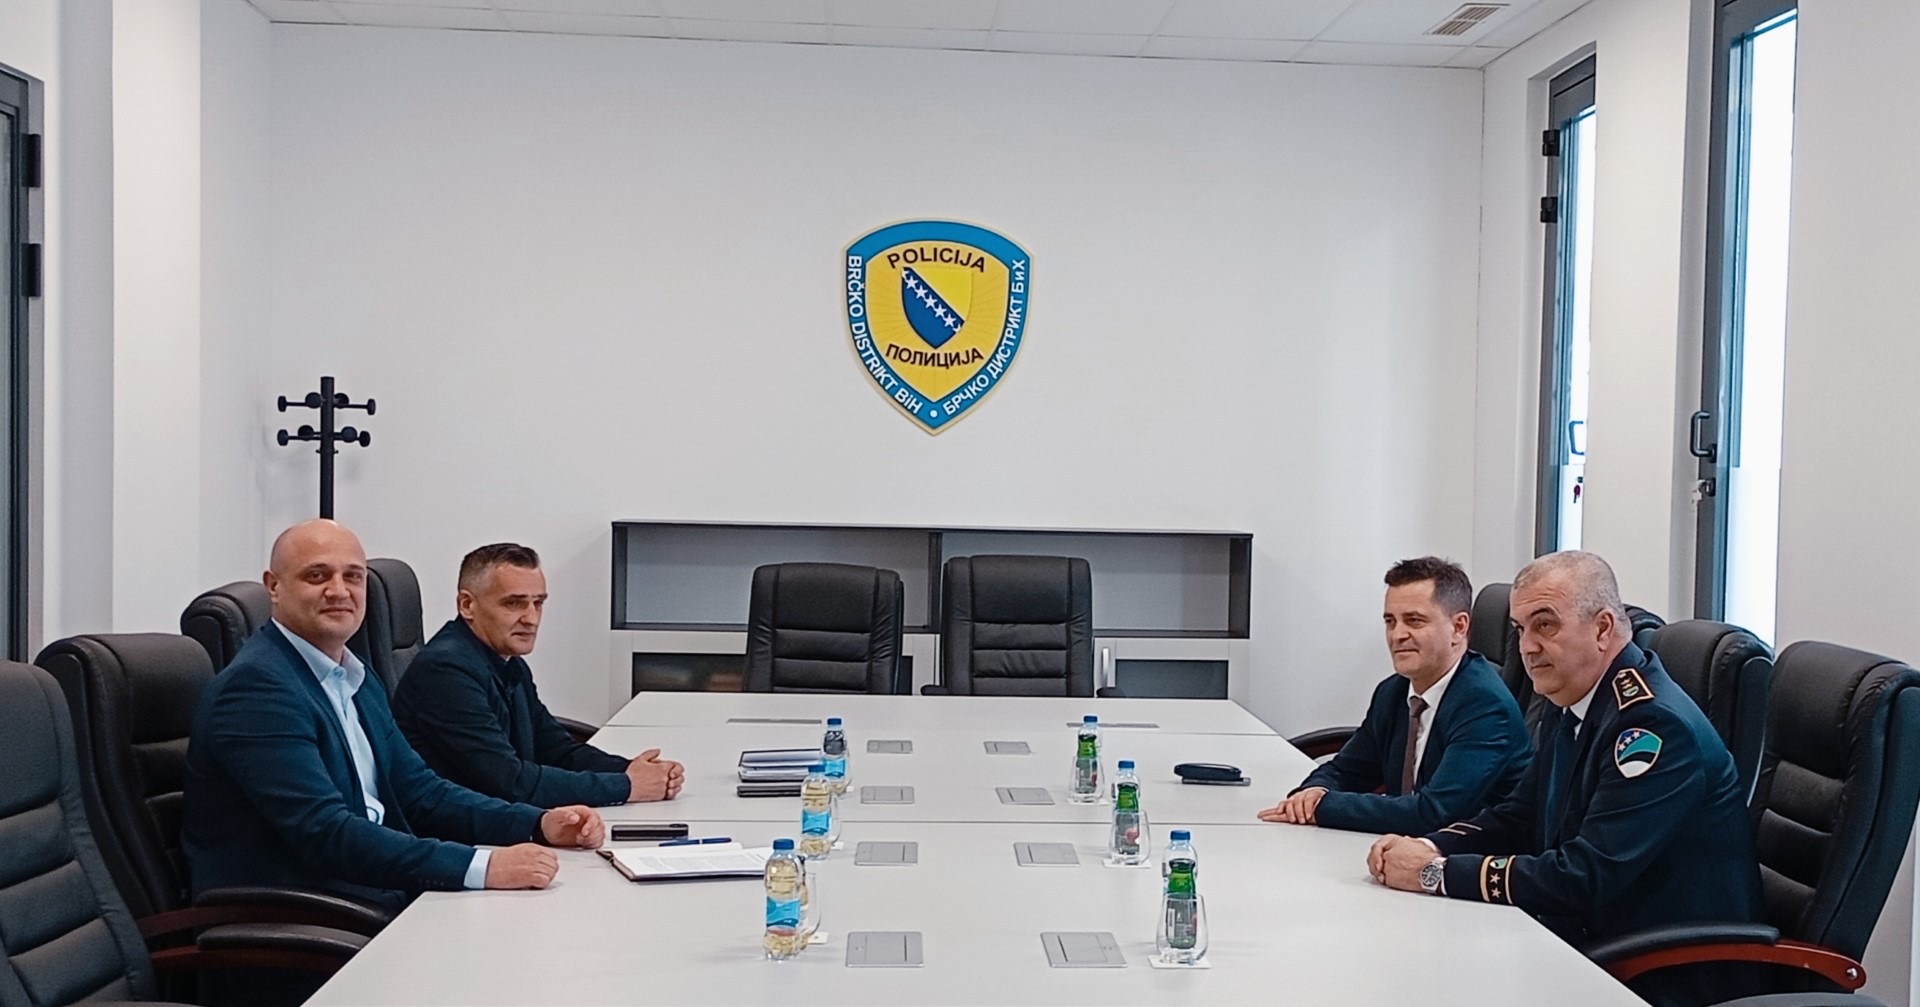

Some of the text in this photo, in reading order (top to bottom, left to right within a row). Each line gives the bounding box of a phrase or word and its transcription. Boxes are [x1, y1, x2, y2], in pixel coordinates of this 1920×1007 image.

[887, 247, 985, 272] POLICIJA
[847, 256, 923, 413] BRČKO DISTRIKT BiH
[886, 344, 984, 369] ПОЛИЦИЈА
[943, 260, 1025, 415] БРЧКО ДИСТРИКТ БиХ
